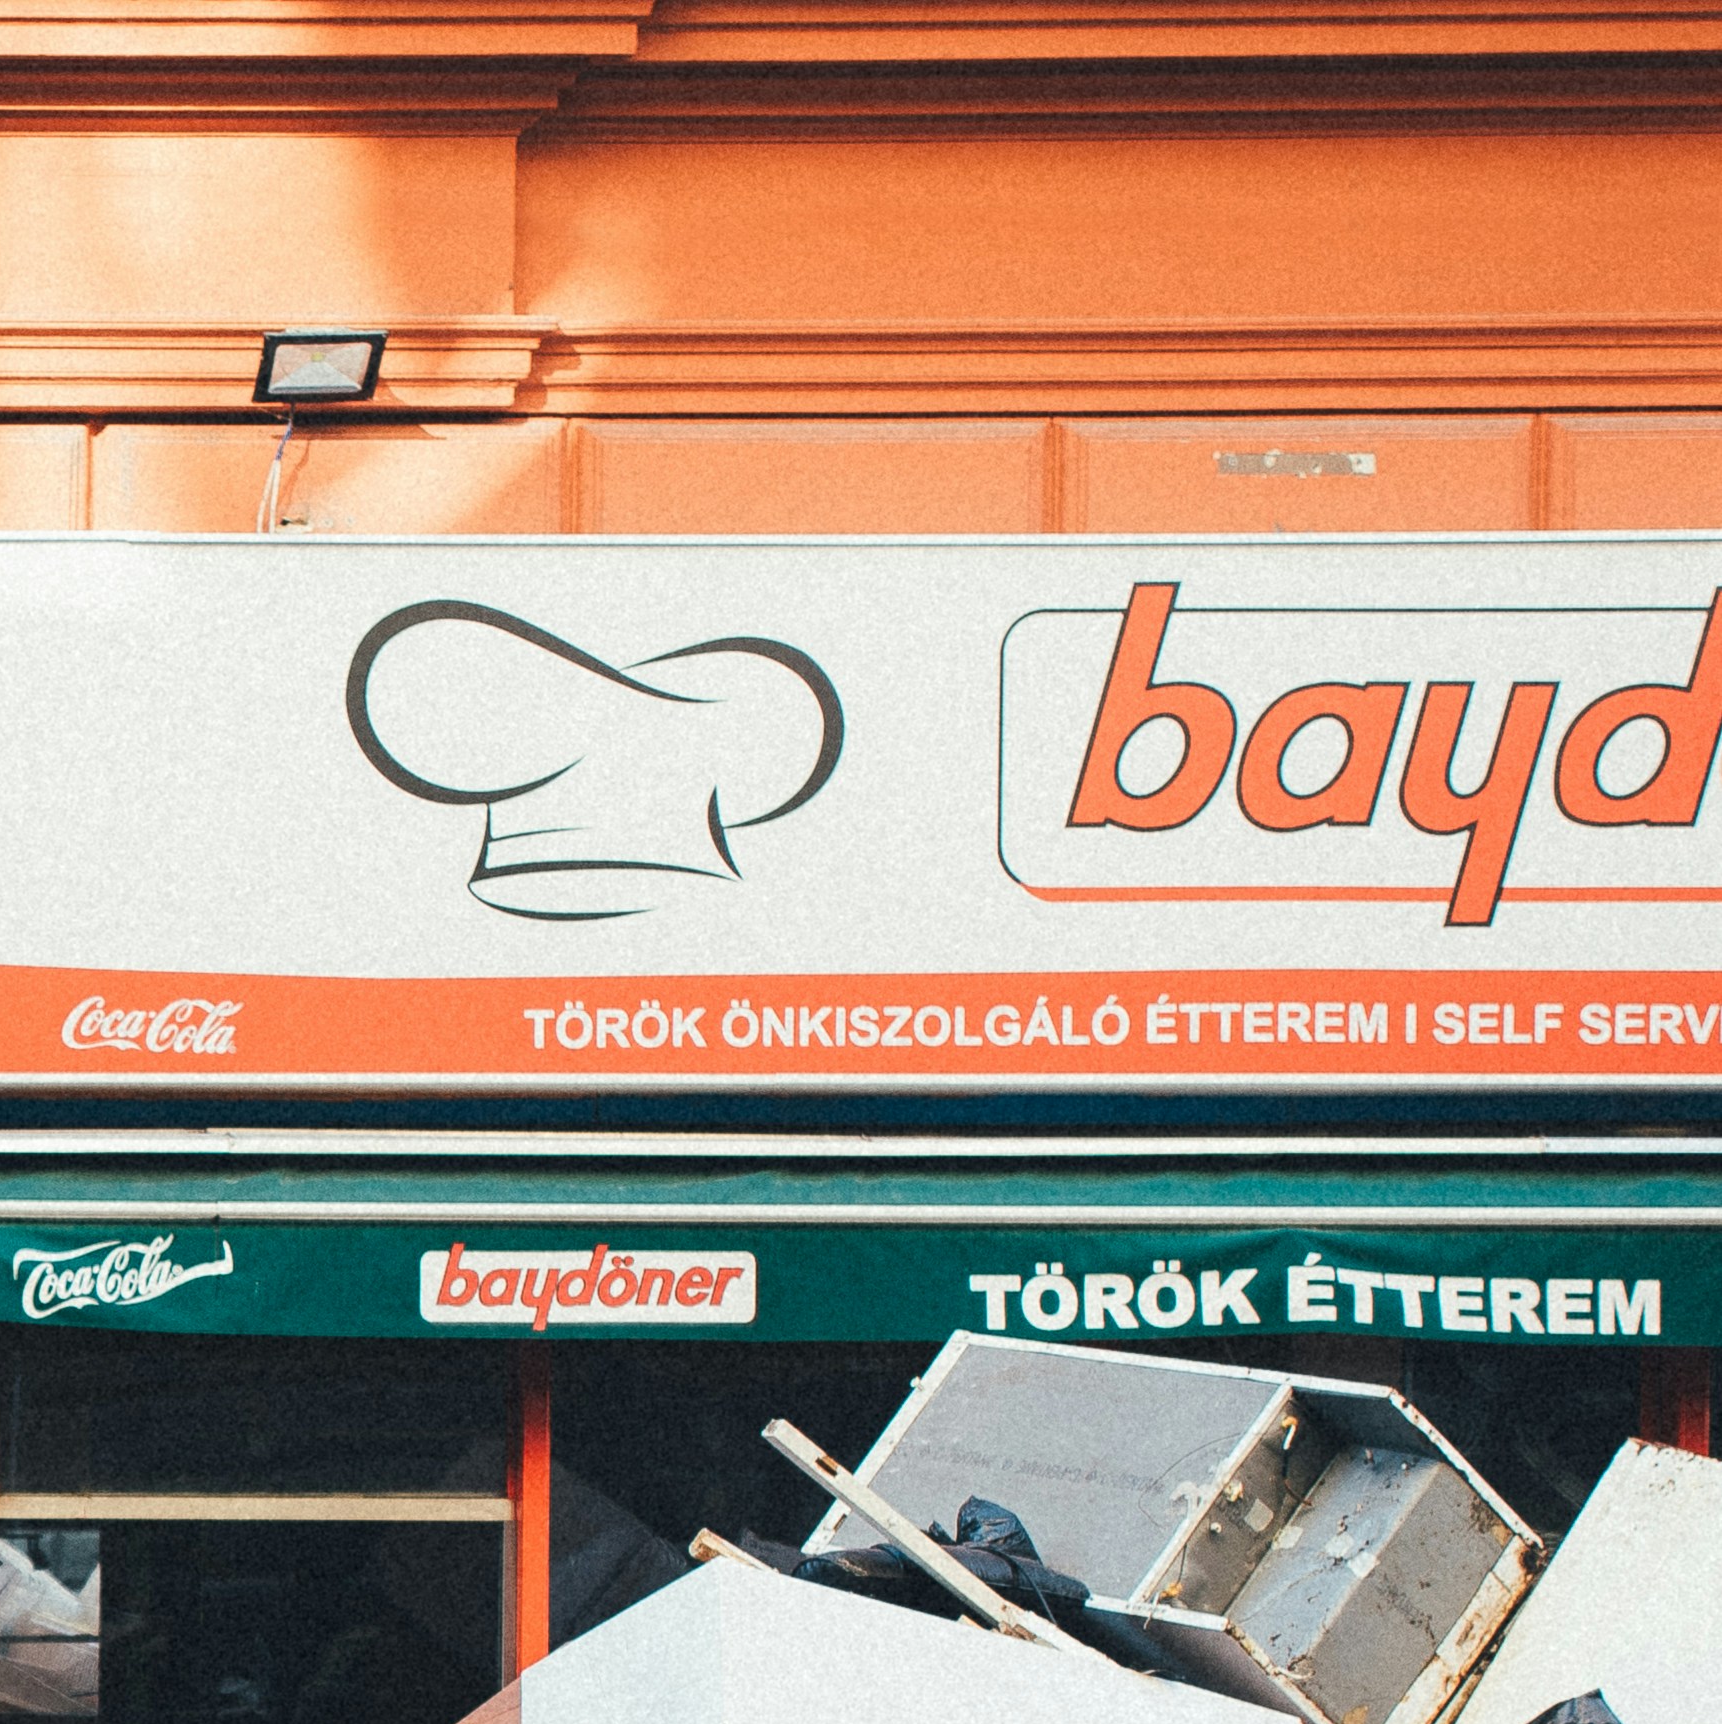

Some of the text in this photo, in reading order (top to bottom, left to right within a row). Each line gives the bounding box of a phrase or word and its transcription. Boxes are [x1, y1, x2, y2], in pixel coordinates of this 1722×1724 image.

[62, 996, 242, 1054] Coca-Cola
[524, 1000, 706, 1049] TÖRÖK
[722, 995, 1129, 1047] ÖNKISZOLGÁLÓ
[1146, 994, 1387, 1043] ÉTTEREM
[1433, 1003, 1563, 1044] SELF
[14, 1233, 202, 1320] Coca-Cola
[437, 1243, 744, 1331] baydöner
[969, 1252, 1660, 1335] TÖRÖK ÉTTEREM
